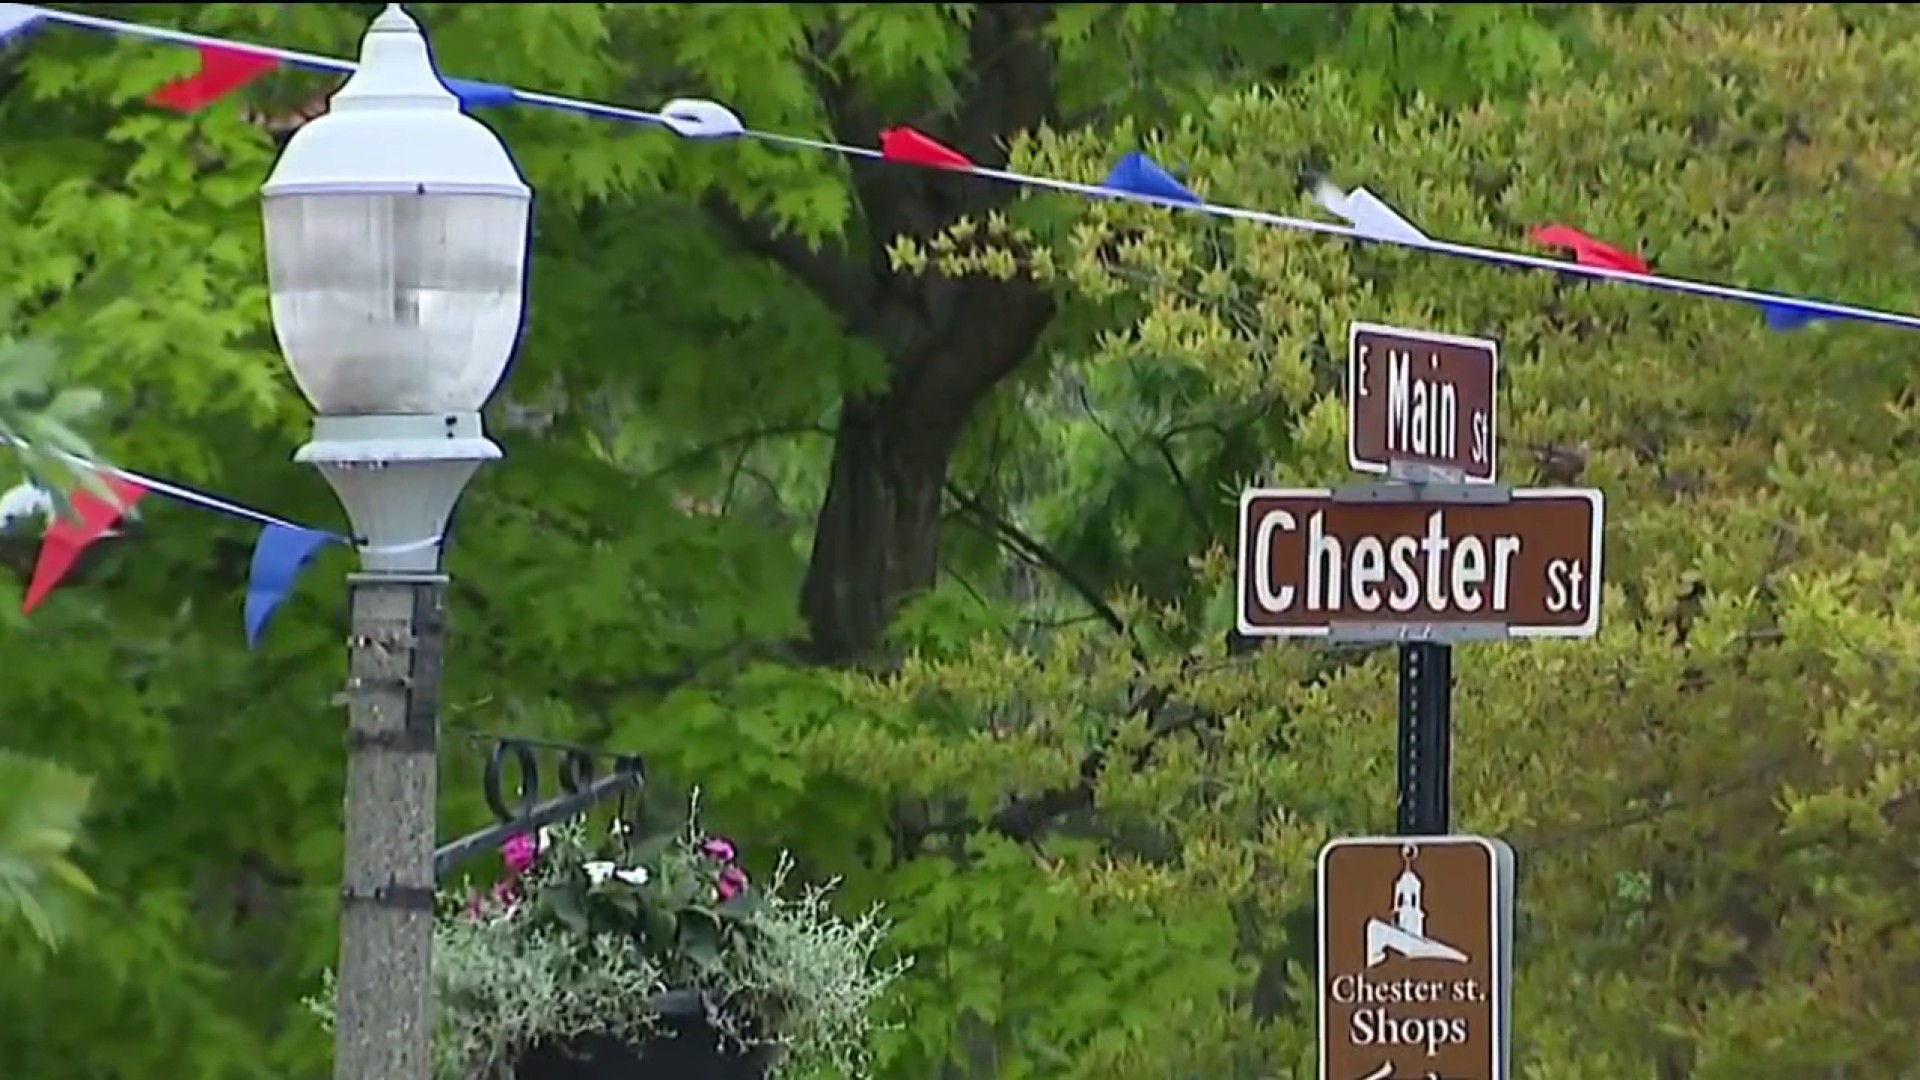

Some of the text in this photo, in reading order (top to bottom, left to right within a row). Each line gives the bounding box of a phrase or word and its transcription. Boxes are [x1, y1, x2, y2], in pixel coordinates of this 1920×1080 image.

[1359, 346, 1488, 463] E Main St
[1254, 509, 1583, 612] Chester St
[1332, 973, 1485, 1003] Chester st.
[1351, 1008, 1467, 1057] Shops
